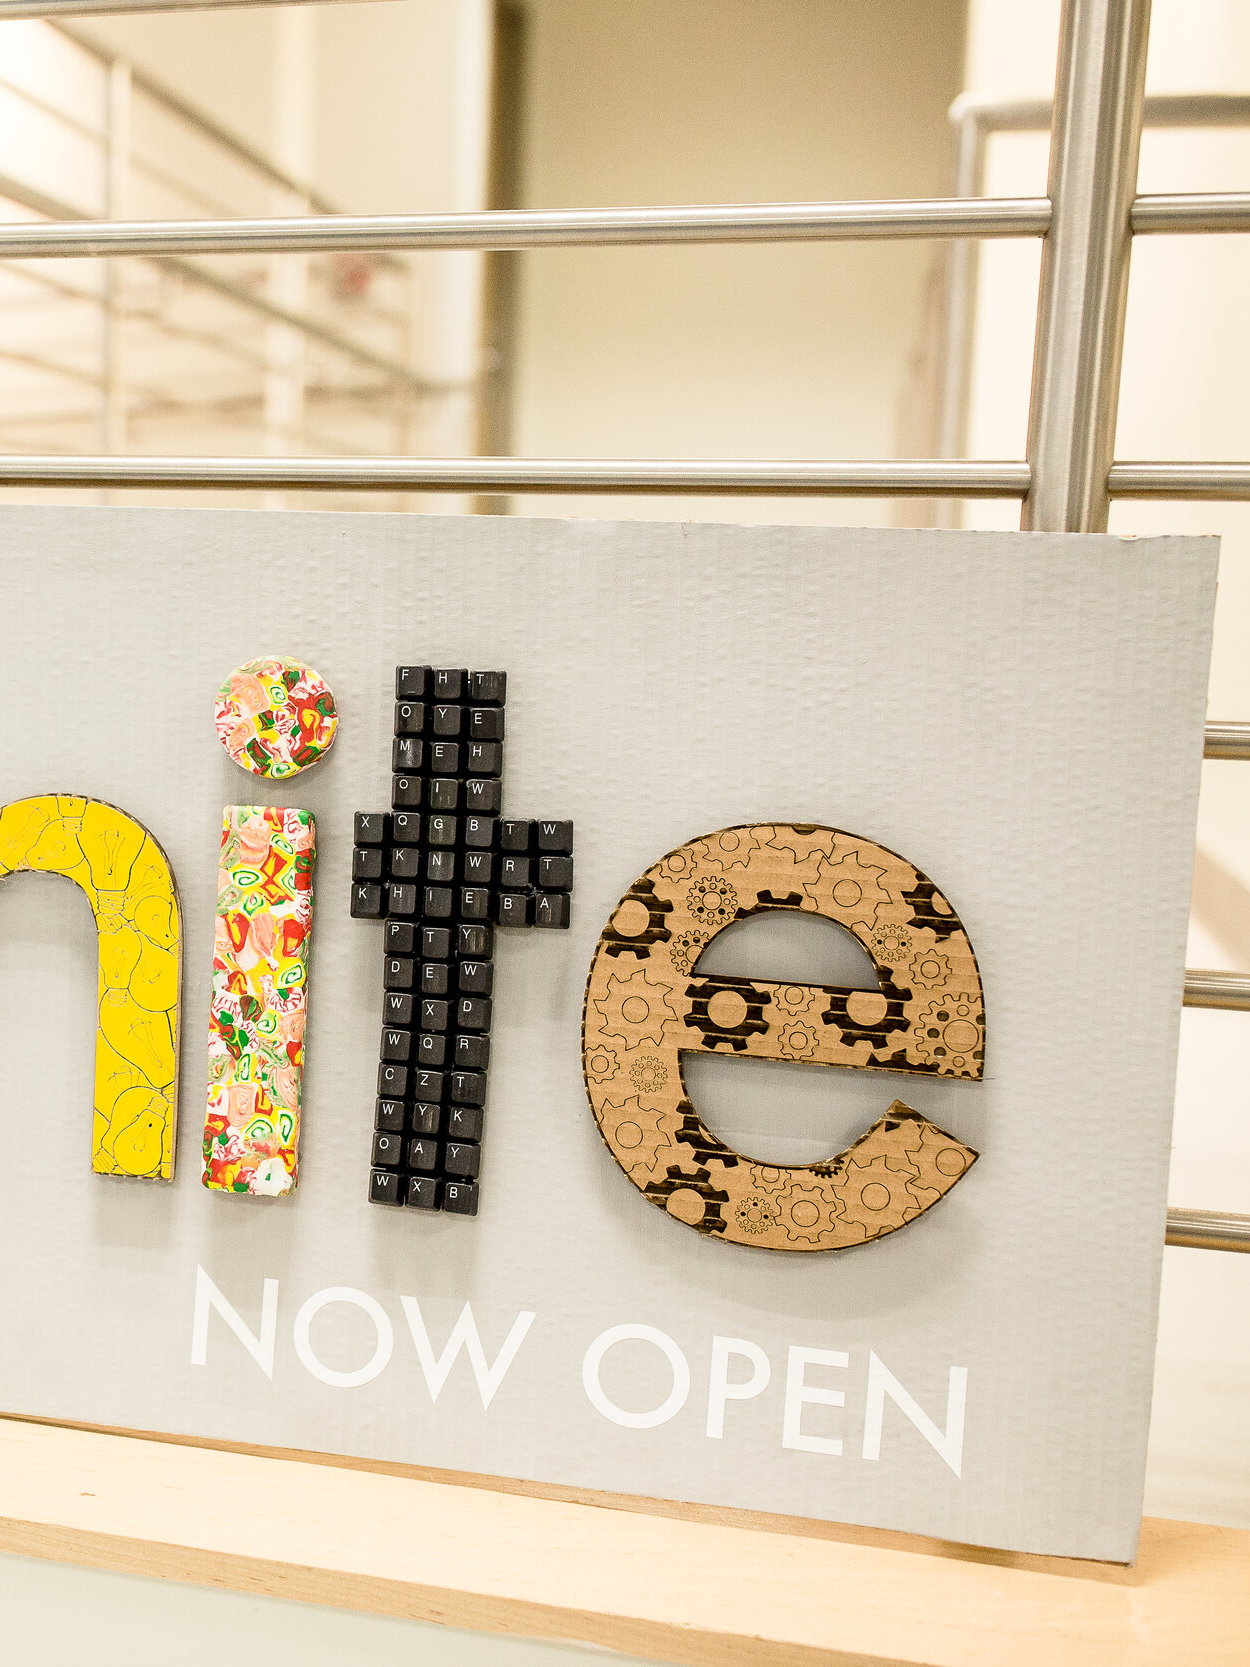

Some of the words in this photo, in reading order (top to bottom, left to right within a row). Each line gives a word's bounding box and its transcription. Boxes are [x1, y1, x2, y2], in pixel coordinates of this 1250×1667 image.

[401, 669, 410, 681] F
[438, 672, 448, 684] H
[476, 673, 485, 685] T
[401, 705, 412, 718] O
[438, 708, 448, 719] Y
[474, 712, 483, 725] E
[399, 740, 411, 751] M
[435, 745, 444, 757] E
[472, 745, 482, 757] H
[399, 778, 409, 790] O
[435, 782, 439, 793] I
[471, 783, 484, 795] W
[360, 816, 370, 828] X
[397, 815, 408, 827] Q
[433, 818, 444, 830] G
[469, 819, 479, 831] B
[506, 823, 515, 835] T
[543, 824, 557, 835] W
[359, 851, 368, 862] T
[395, 849, 405, 861] K
[432, 854, 442, 866] N
[469, 856, 482, 868] W
[505, 860, 515, 872] R
[543, 858, 553, 870] T
[358, 887, 367, 899] K
[393, 886, 403, 898] H
[428, 890, 433, 901] I
[465, 892, 474, 904] E
[503, 897, 513, 910] B
[539, 897, 550, 909] A
[391, 925, 400, 936] P
[426, 931, 435, 943] T
[462, 928, 471, 940] Y
[391, 961, 401, 973] D
[425, 967, 434, 979] E
[463, 964, 478, 976] W
[390, 997, 404, 1009] W
[425, 1004, 435, 1016] X
[462, 1001, 472, 1013] D
[388, 1034, 401, 1045] W
[422, 1037, 433, 1050] Q
[459, 1038, 469, 1050] R
[384, 1068, 395, 1080] C
[419, 1074, 429, 1086] Z
[456, 1076, 465, 1088] T
[382, 1104, 395, 1115] W
[418, 1105, 428, 1116] Y
[453, 1110, 463, 1122] K
[378, 1138, 389, 1149] O
[414, 1142, 424, 1154] A
[450, 1147, 460, 1159] Y
[376, 1175, 389, 1186] W
[412, 1181, 422, 1193] X
[449, 1186, 459, 1199] B
[190, 1264, 537, 1411] NOW
[582, 1323, 968, 1479] OPEN
